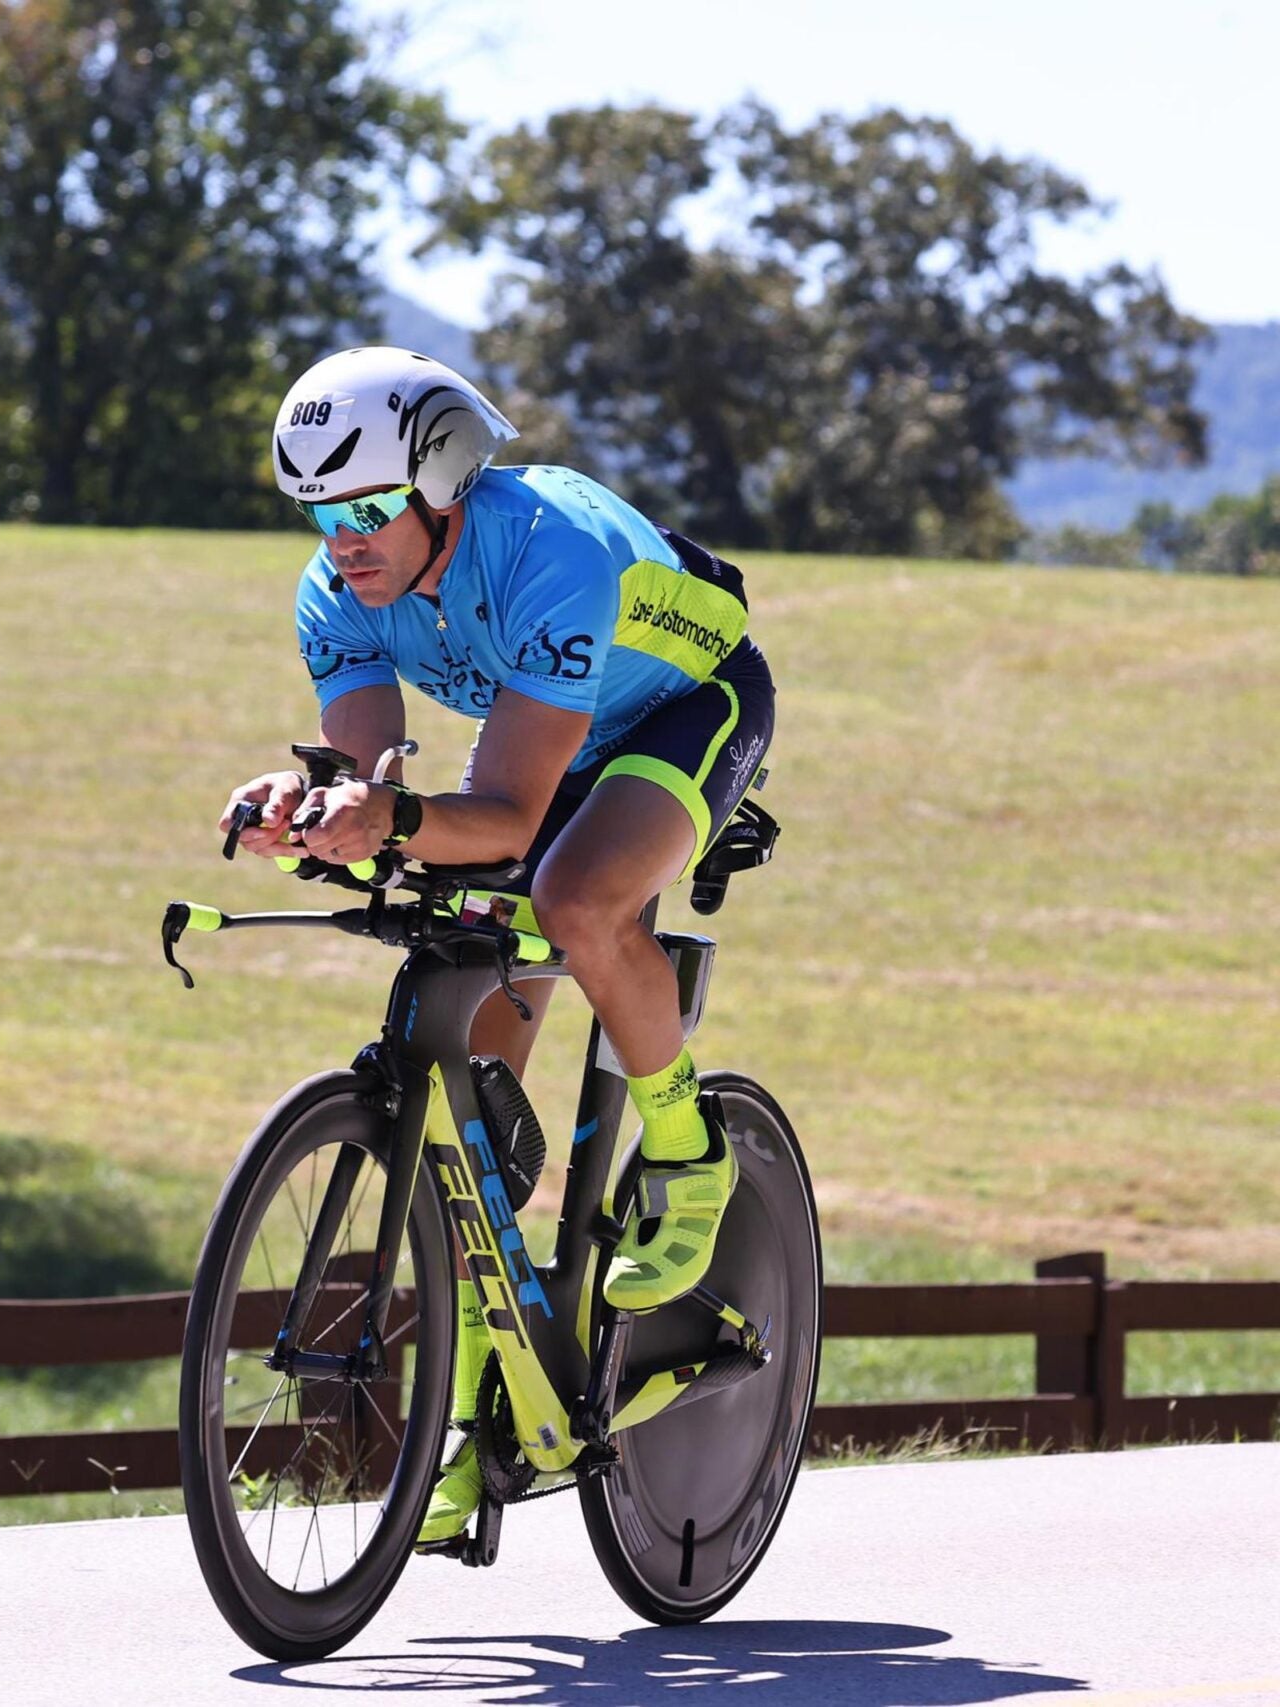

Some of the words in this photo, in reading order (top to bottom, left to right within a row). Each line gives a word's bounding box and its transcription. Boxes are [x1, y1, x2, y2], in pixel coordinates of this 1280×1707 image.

[290, 401, 332, 426] 809
[428, 1143, 527, 1349] FELT
[464, 1119, 554, 1318] FELT
